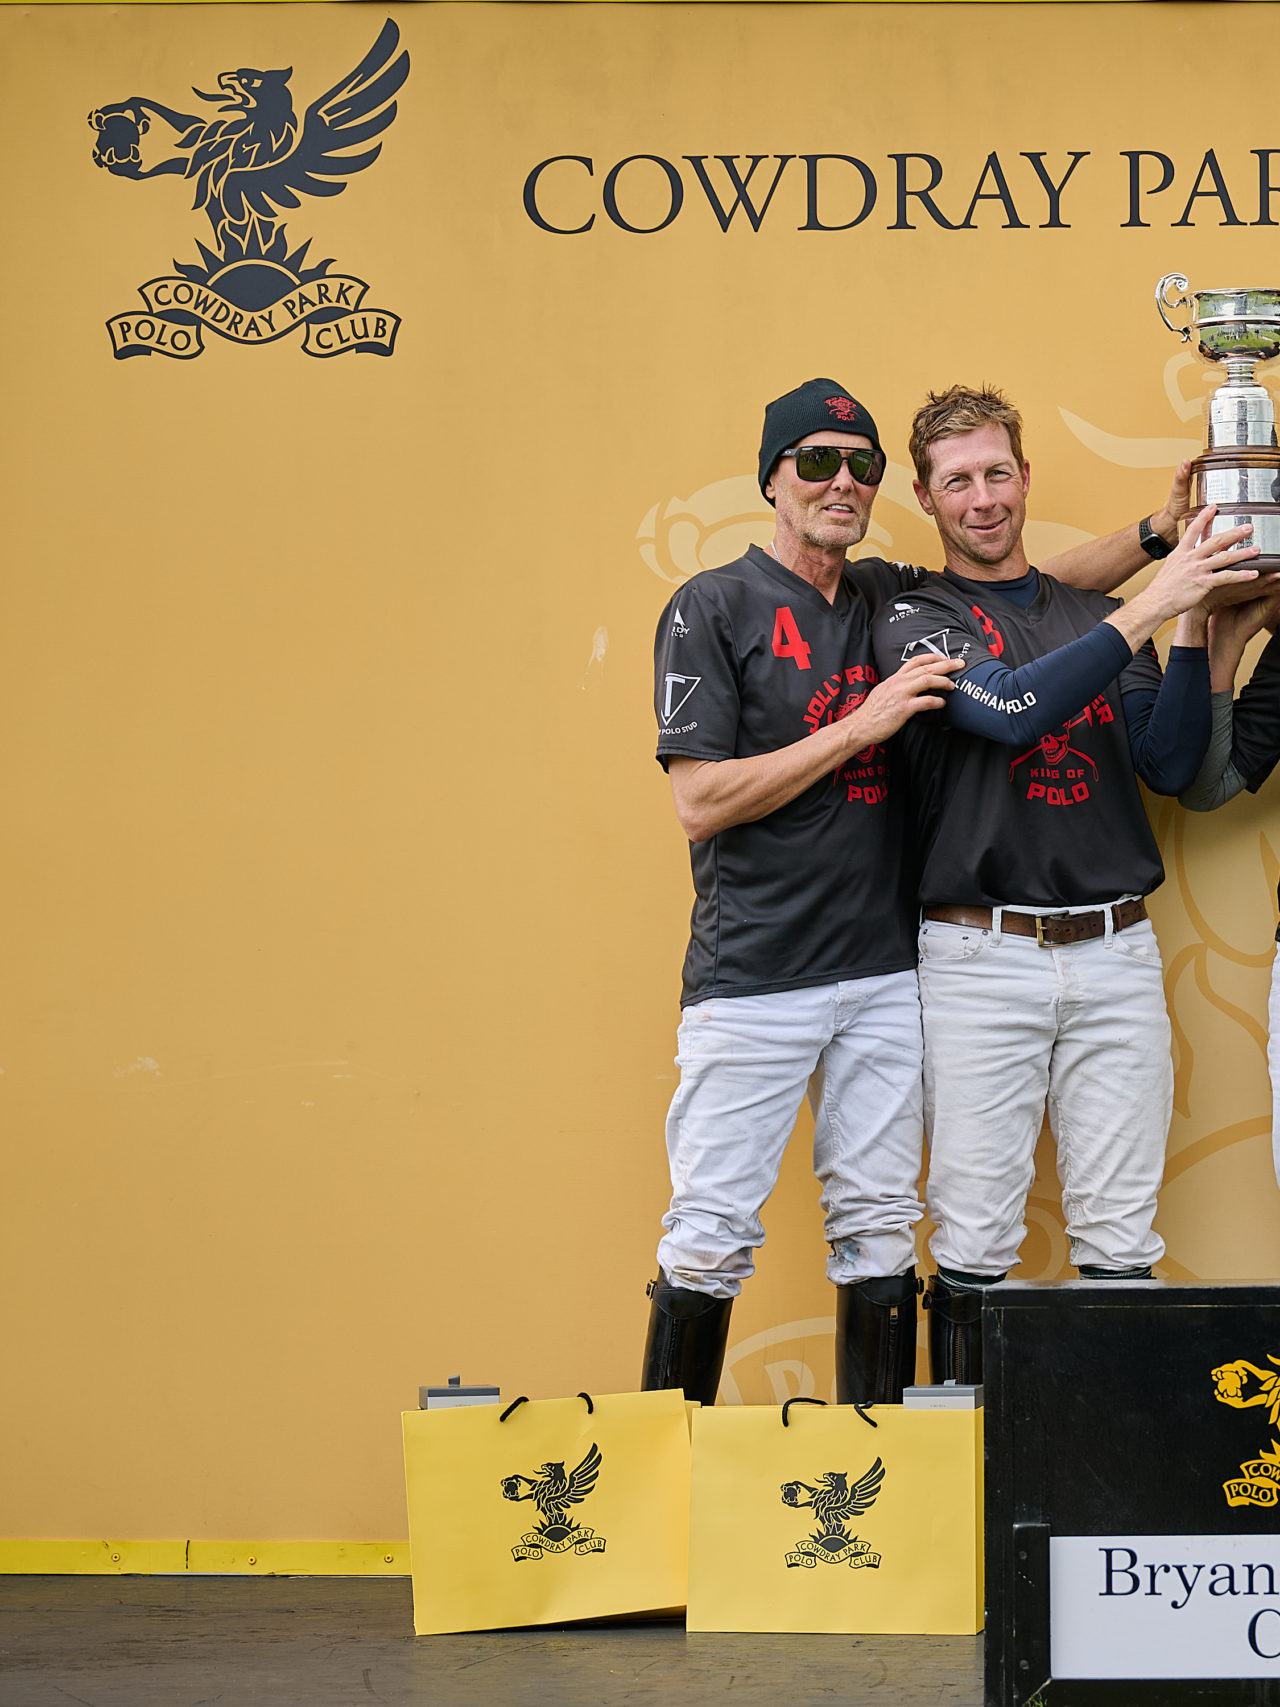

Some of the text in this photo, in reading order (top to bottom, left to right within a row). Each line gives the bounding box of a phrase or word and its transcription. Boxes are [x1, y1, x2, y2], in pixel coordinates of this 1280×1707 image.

[522, 150, 1091, 234] COWDRAY
[153, 282, 356, 338] COWDRAY PARK
[118, 316, 388, 351] POLO CLUB
[771, 606, 812, 671] 4
[661, 727, 681, 735] POLO
[682, 721, 698, 733] STUD
[1067, 768, 1085, 778] OF
[1026, 781, 1090, 806] POLO
[1229, 1482, 1271, 1503] POLO
[515, 1539, 603, 1558] POLO CLUB
[525, 1529, 590, 1551] COWDRAY PARK
[788, 1554, 878, 1567] POLO CLUB
[800, 1542, 867, 1562] COWDRAY PARK
[1098, 1546, 1280, 1610] Bryan
